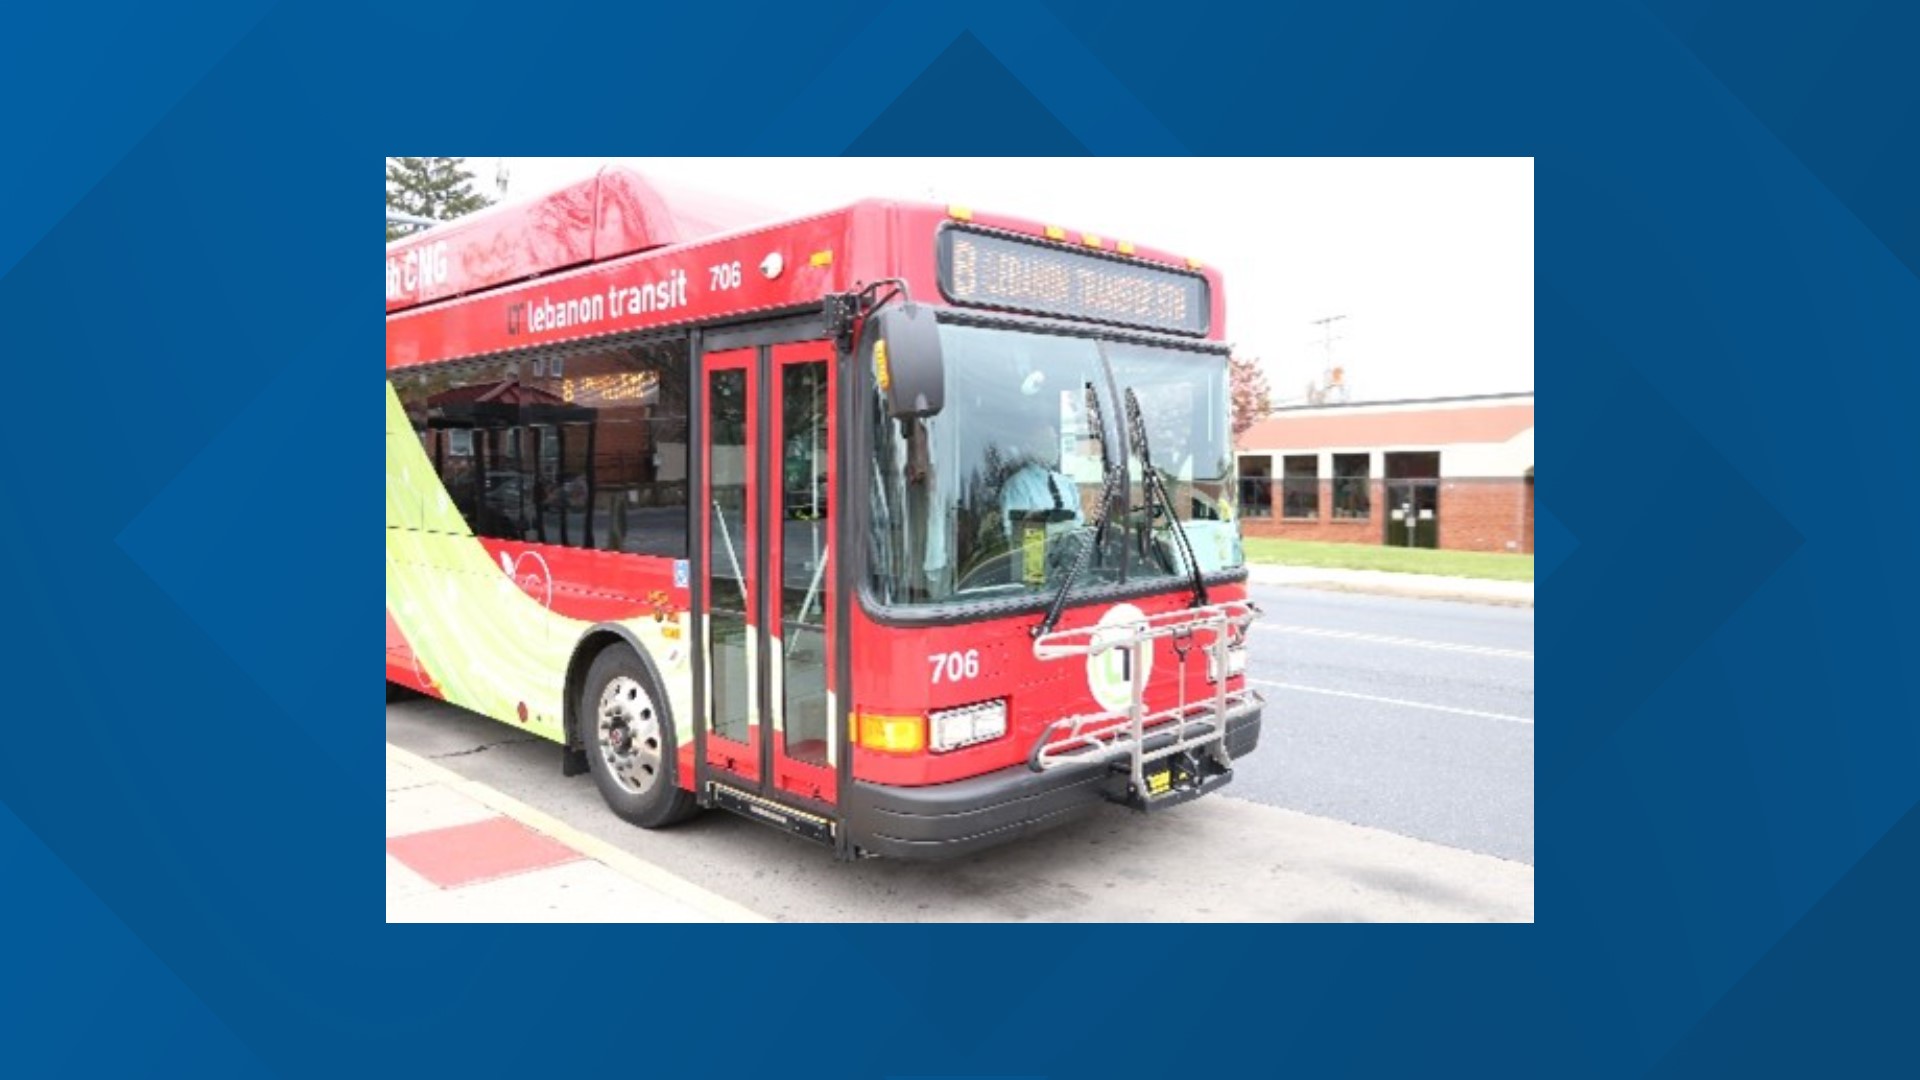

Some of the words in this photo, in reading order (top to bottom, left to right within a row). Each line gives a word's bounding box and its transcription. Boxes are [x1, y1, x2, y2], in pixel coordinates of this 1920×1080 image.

[404, 240, 448, 291] CNG
[709, 261, 742, 291] 706
[528, 294, 604, 333] lebanon
[609, 269, 687, 318] transit
[929, 649, 979, 684] 706
